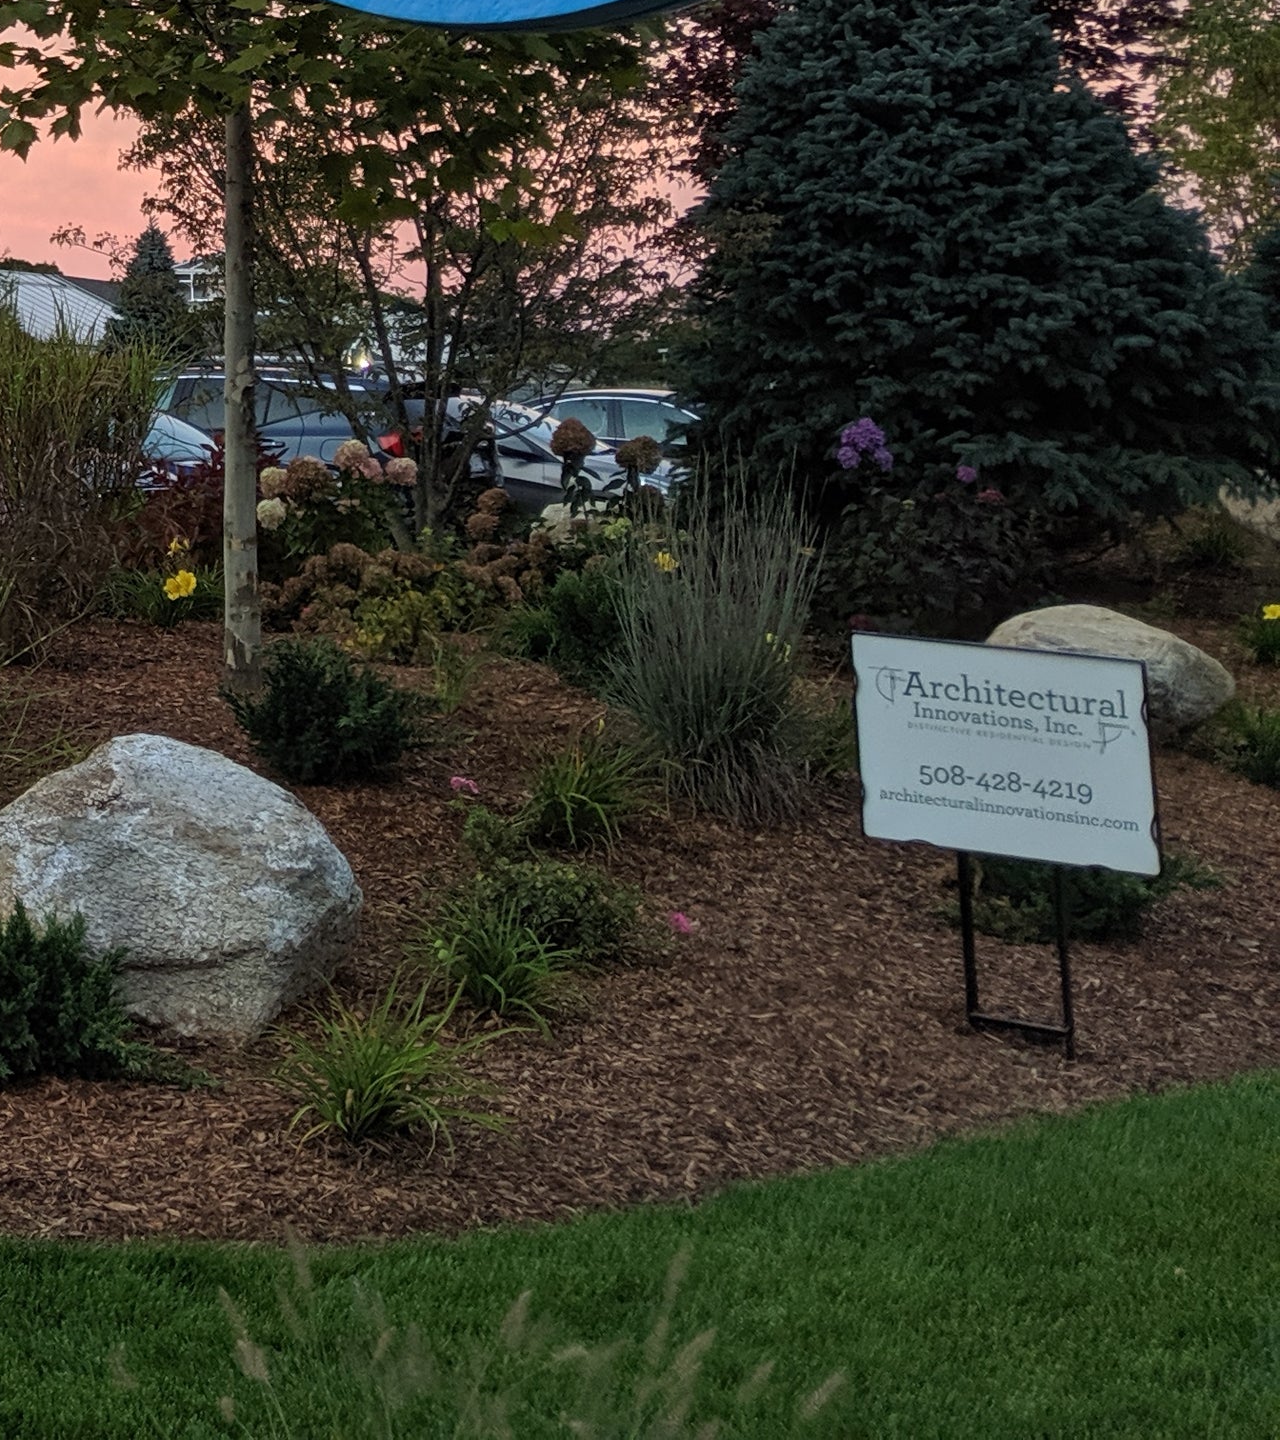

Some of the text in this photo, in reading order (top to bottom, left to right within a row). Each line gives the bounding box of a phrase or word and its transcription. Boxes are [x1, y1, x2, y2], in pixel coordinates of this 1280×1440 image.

[903, 671, 1129, 720] Architectural
[913, 701, 1083, 737] Innovations, Inc.
[919, 764, 1093, 805] 508-428-4219
[880, 788, 1140, 832] architecturalinnovationsinc.com
